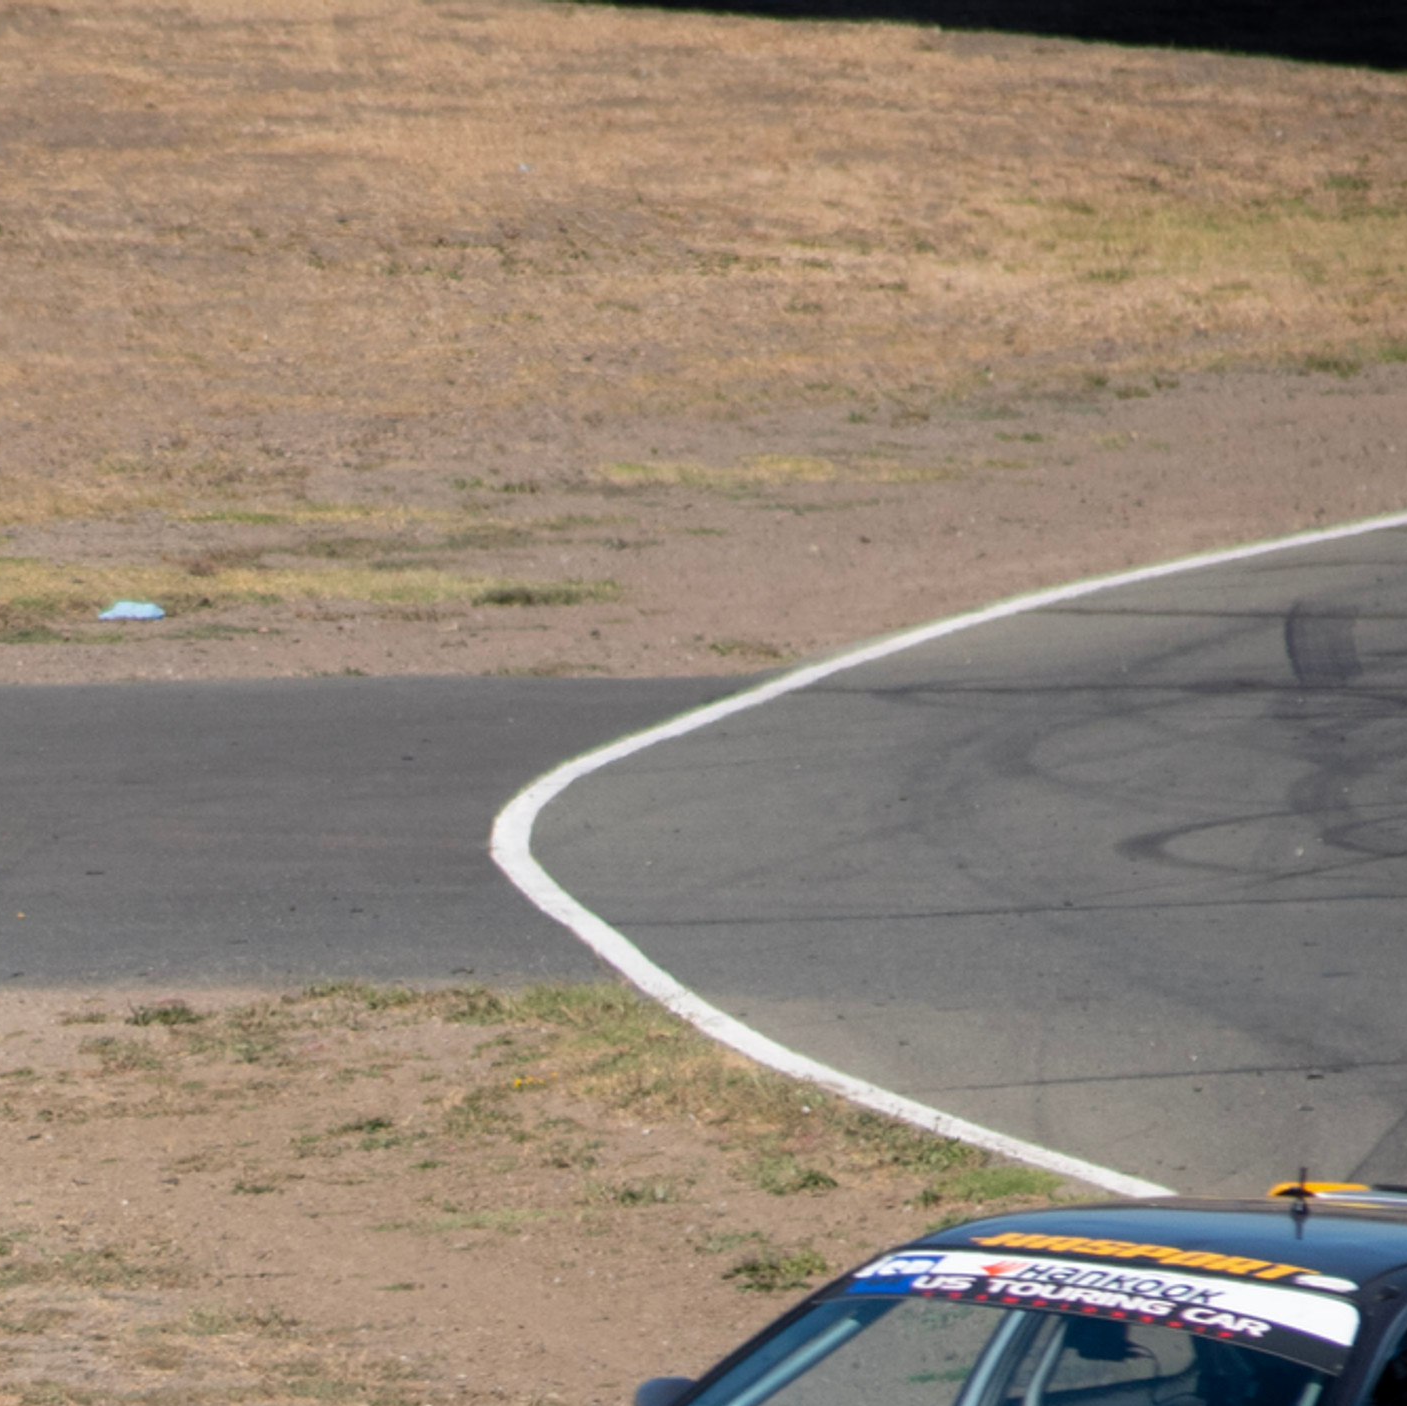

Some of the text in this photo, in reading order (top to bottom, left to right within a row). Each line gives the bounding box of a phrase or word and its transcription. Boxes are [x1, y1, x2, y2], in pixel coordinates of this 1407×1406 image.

[910, 1273, 966, 1292] US
[987, 1276, 1178, 1318] TOURING
[1182, 1300, 1273, 1338] CAR
